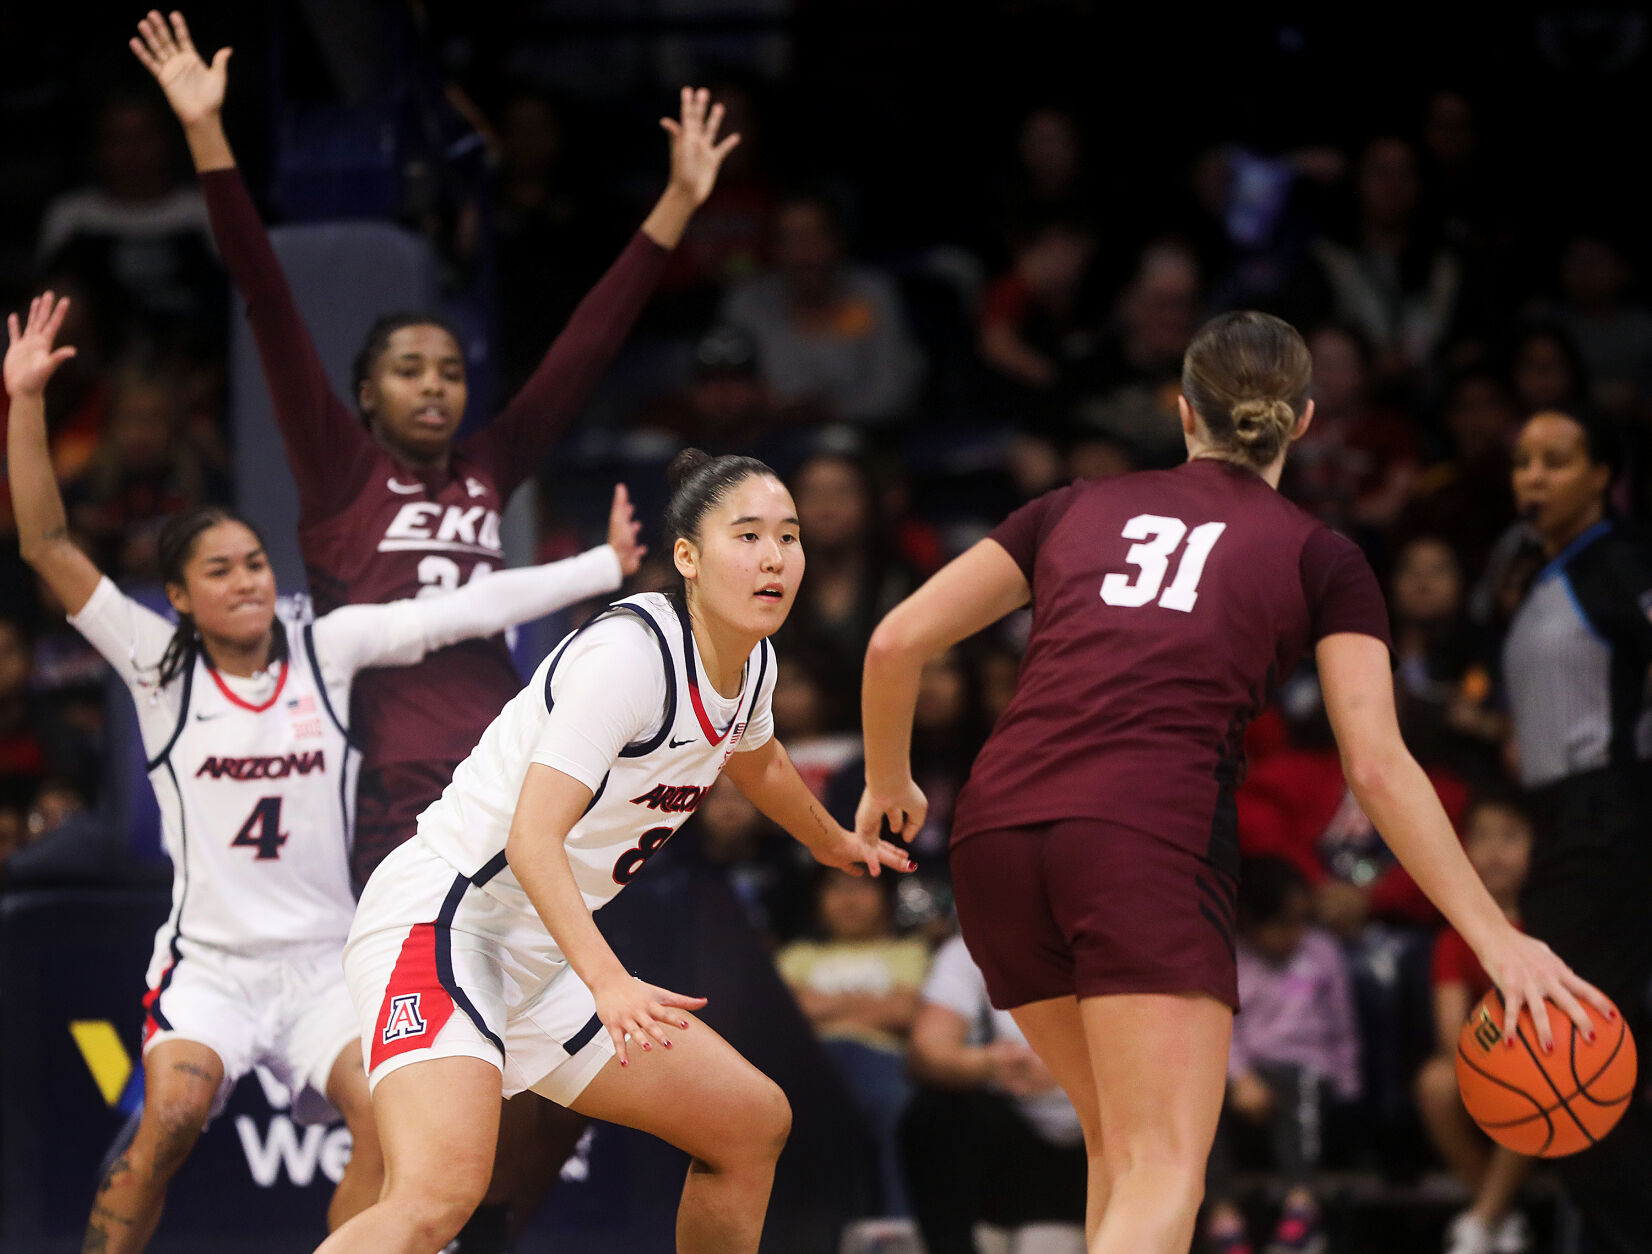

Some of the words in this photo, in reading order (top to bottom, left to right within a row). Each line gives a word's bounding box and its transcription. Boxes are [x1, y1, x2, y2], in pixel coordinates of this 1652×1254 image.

[1100, 513, 1227, 613] 31
[195, 749, 326, 780] ARIZONA
[230, 795, 291, 861] 4
[612, 826, 674, 885] 8
[383, 992, 428, 1045] A
